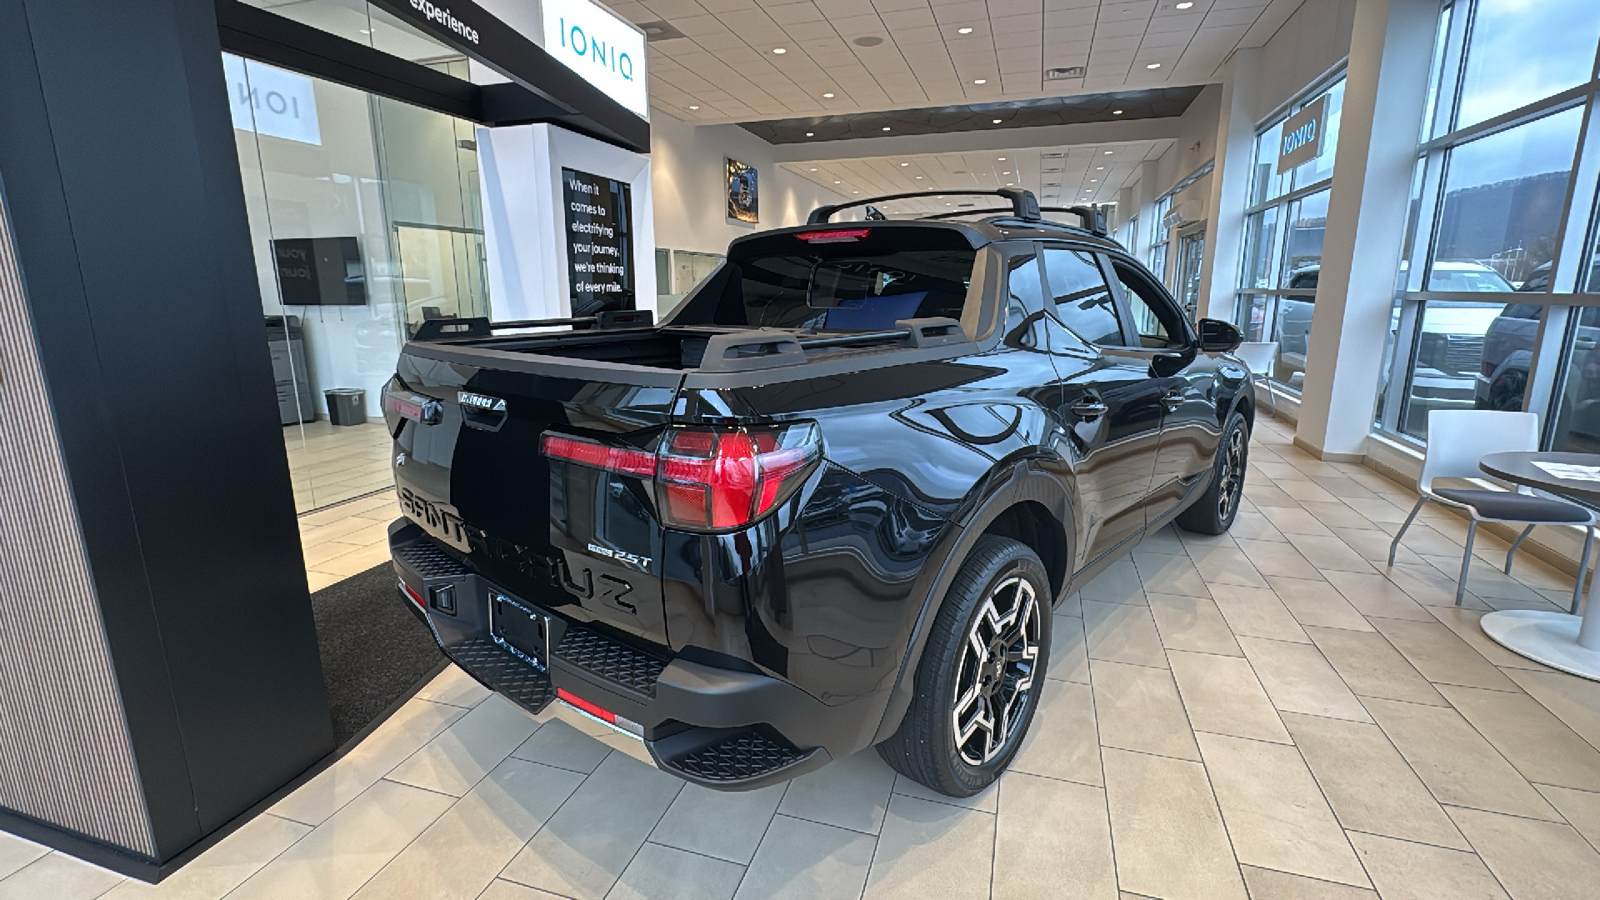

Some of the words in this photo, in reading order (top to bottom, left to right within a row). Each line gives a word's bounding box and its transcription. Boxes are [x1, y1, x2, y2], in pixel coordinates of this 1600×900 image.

[409, 0, 479, 45] experience
[560, 17, 633, 82] IONIQ
[569, 178, 593, 194] When
[593, 183, 600, 196] it
[570, 202, 597, 215] comes
[598, 205, 606, 216] to
[571, 220, 614, 239] electrifying
[573, 243, 591, 254] your
[591, 241, 620, 258] journey,
[574, 262, 596, 273] we're
[596, 262, 624, 276] thinking
[576, 280, 584, 293] of
[585, 283, 605, 295] every
[606, 281, 623, 293] mile.
